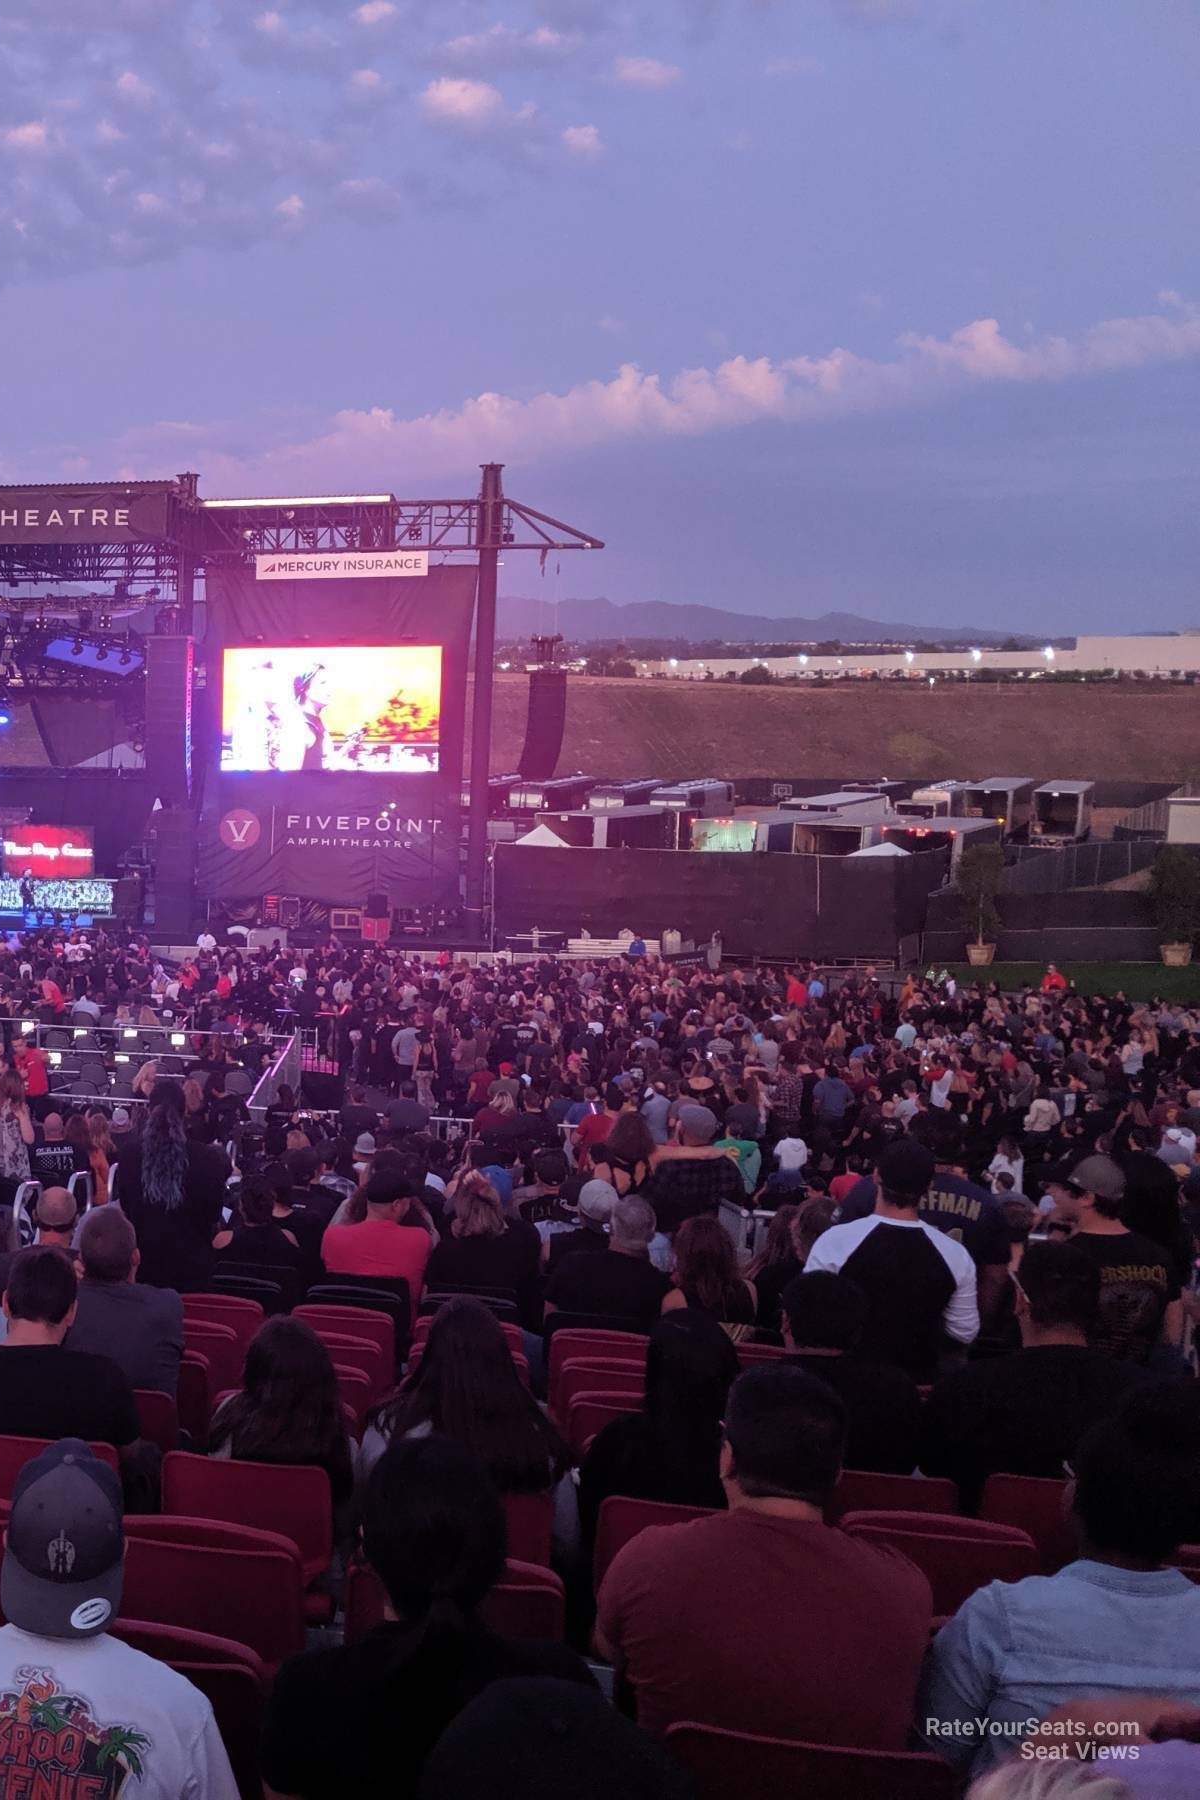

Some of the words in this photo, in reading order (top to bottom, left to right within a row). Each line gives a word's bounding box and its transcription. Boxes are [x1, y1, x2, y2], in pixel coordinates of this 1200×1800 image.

[277, 561, 341, 572] MERCURY
[343, 558, 422, 571] INSURANCE
[225, 820, 253, 843] V
[287, 815, 443, 834] FIVEPOINT
[286, 837, 412, 850] AMPHITHEATRE
